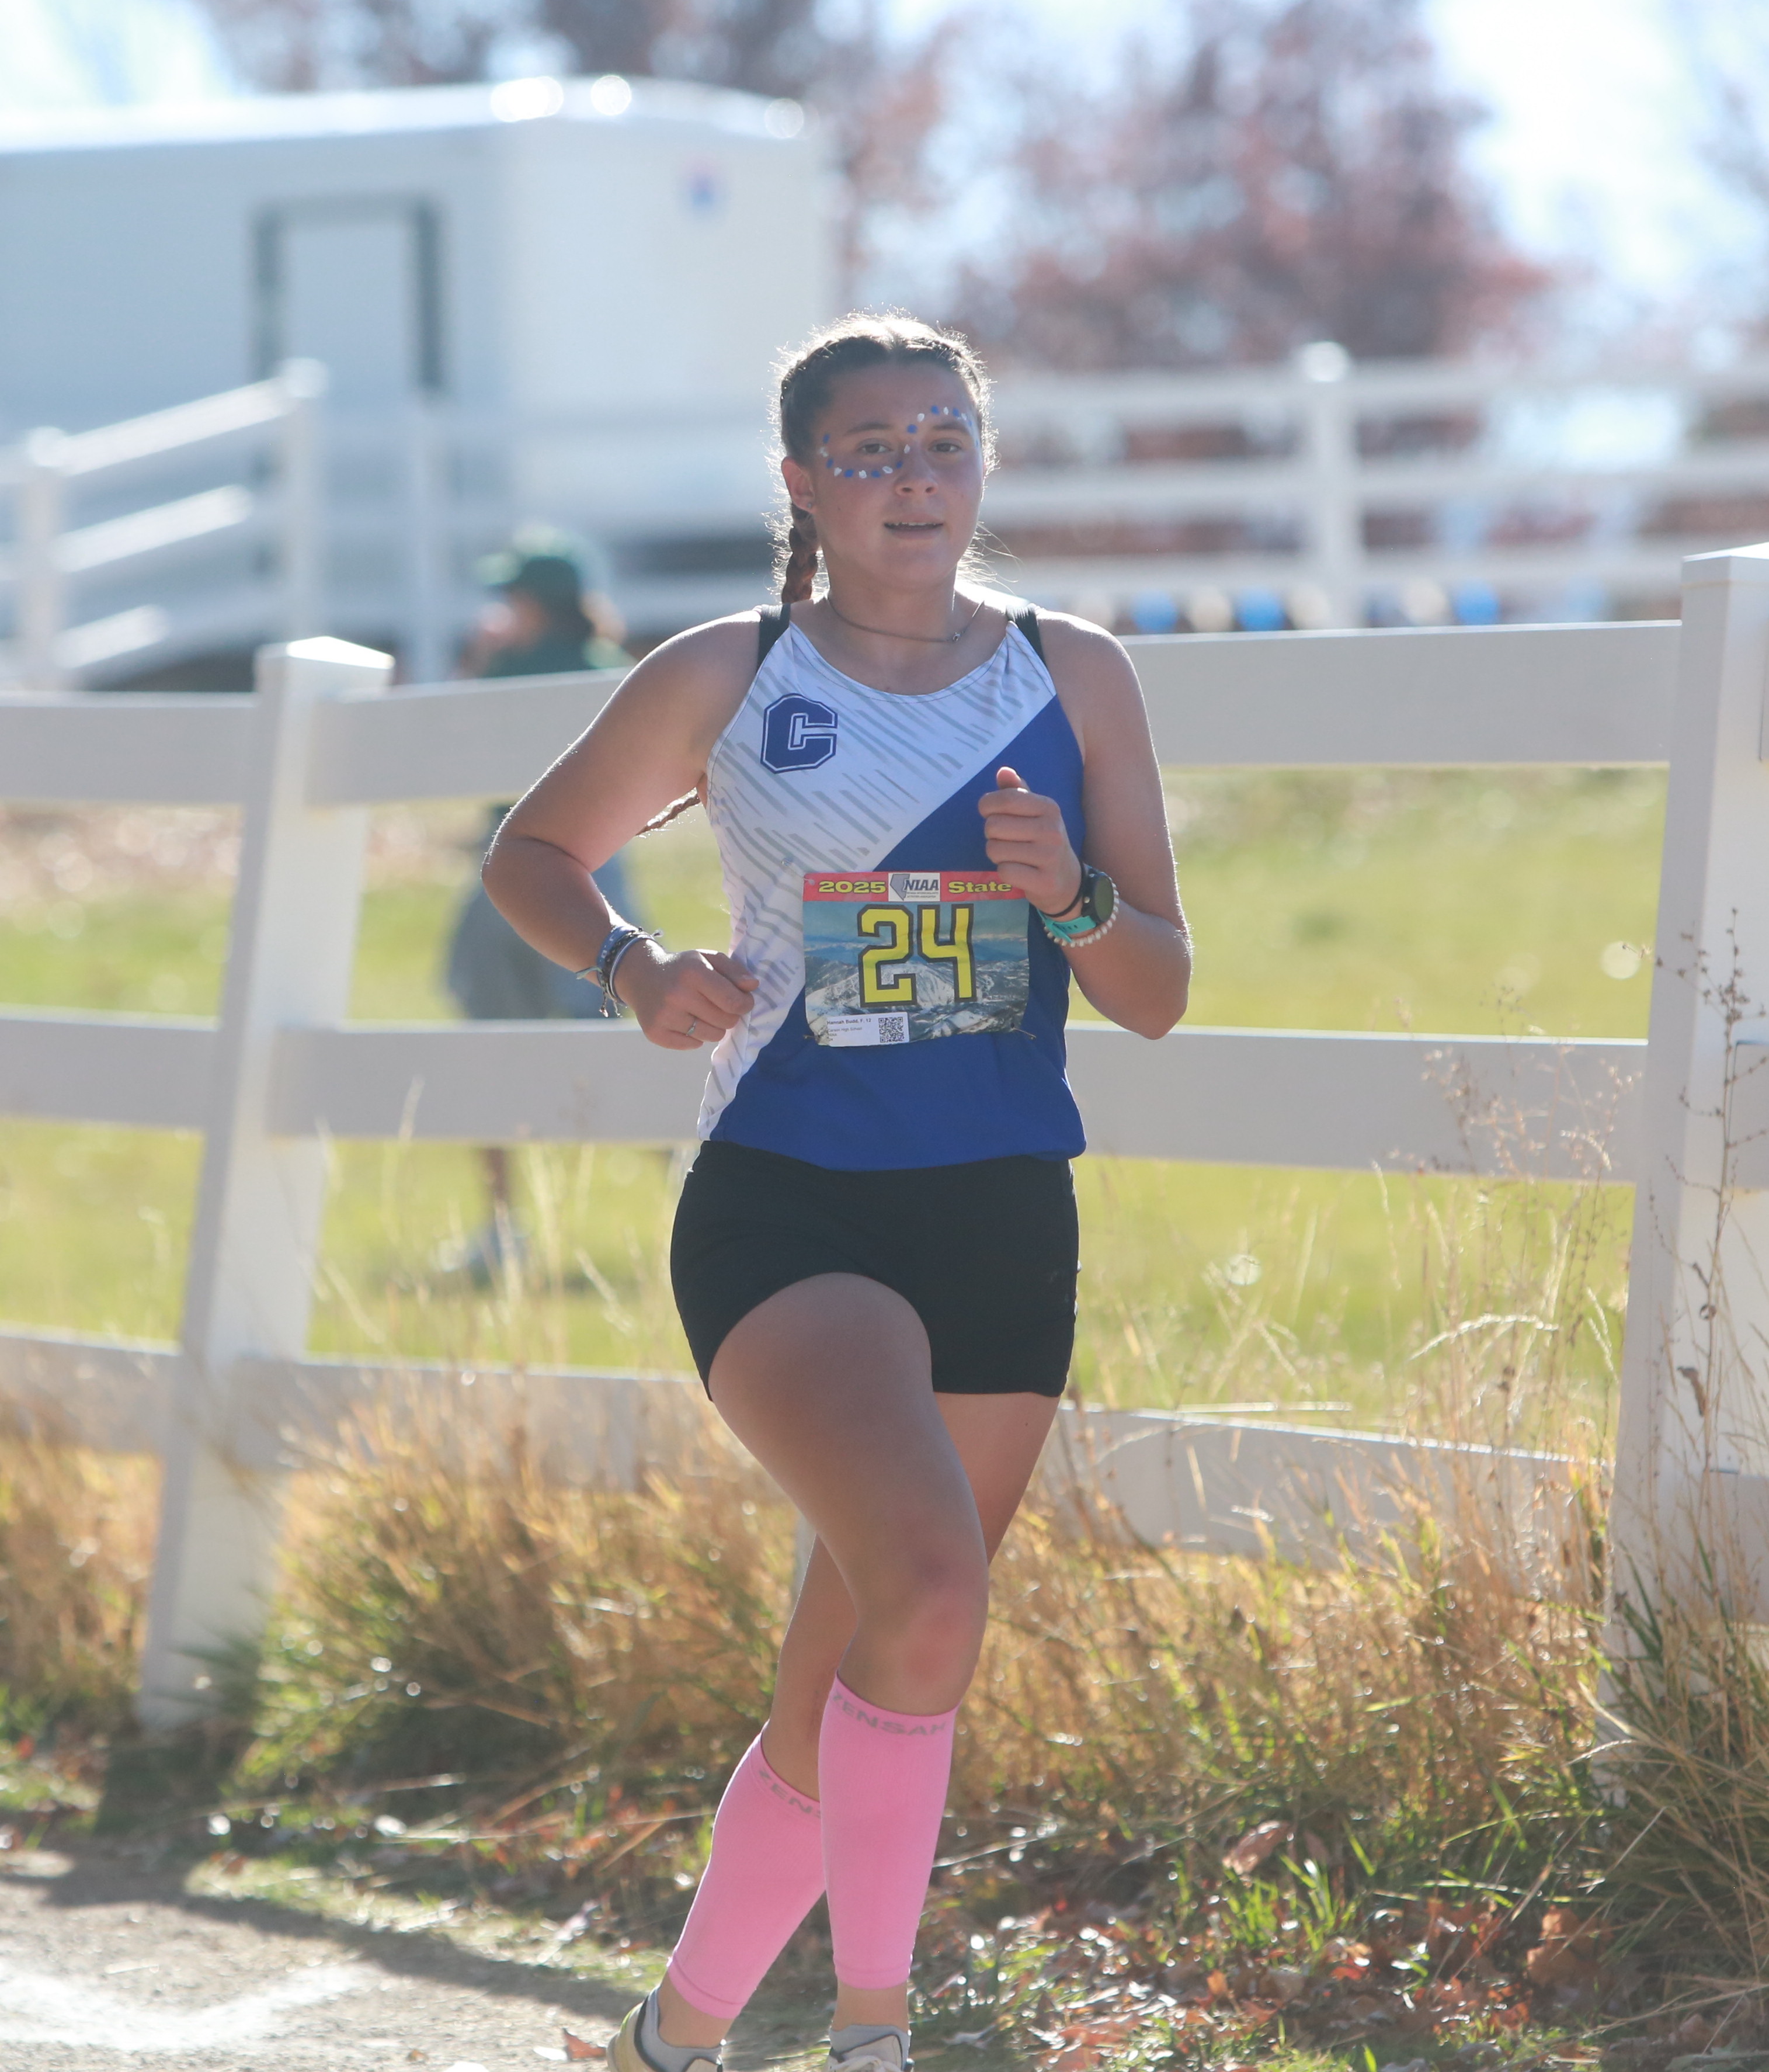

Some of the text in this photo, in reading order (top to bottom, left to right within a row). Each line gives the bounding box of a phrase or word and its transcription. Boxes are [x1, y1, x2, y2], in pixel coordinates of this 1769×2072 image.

[760, 693, 838, 774] C
[818, 879, 1012, 894] 2025 NIAA State
[857, 904, 977, 1008] 24
